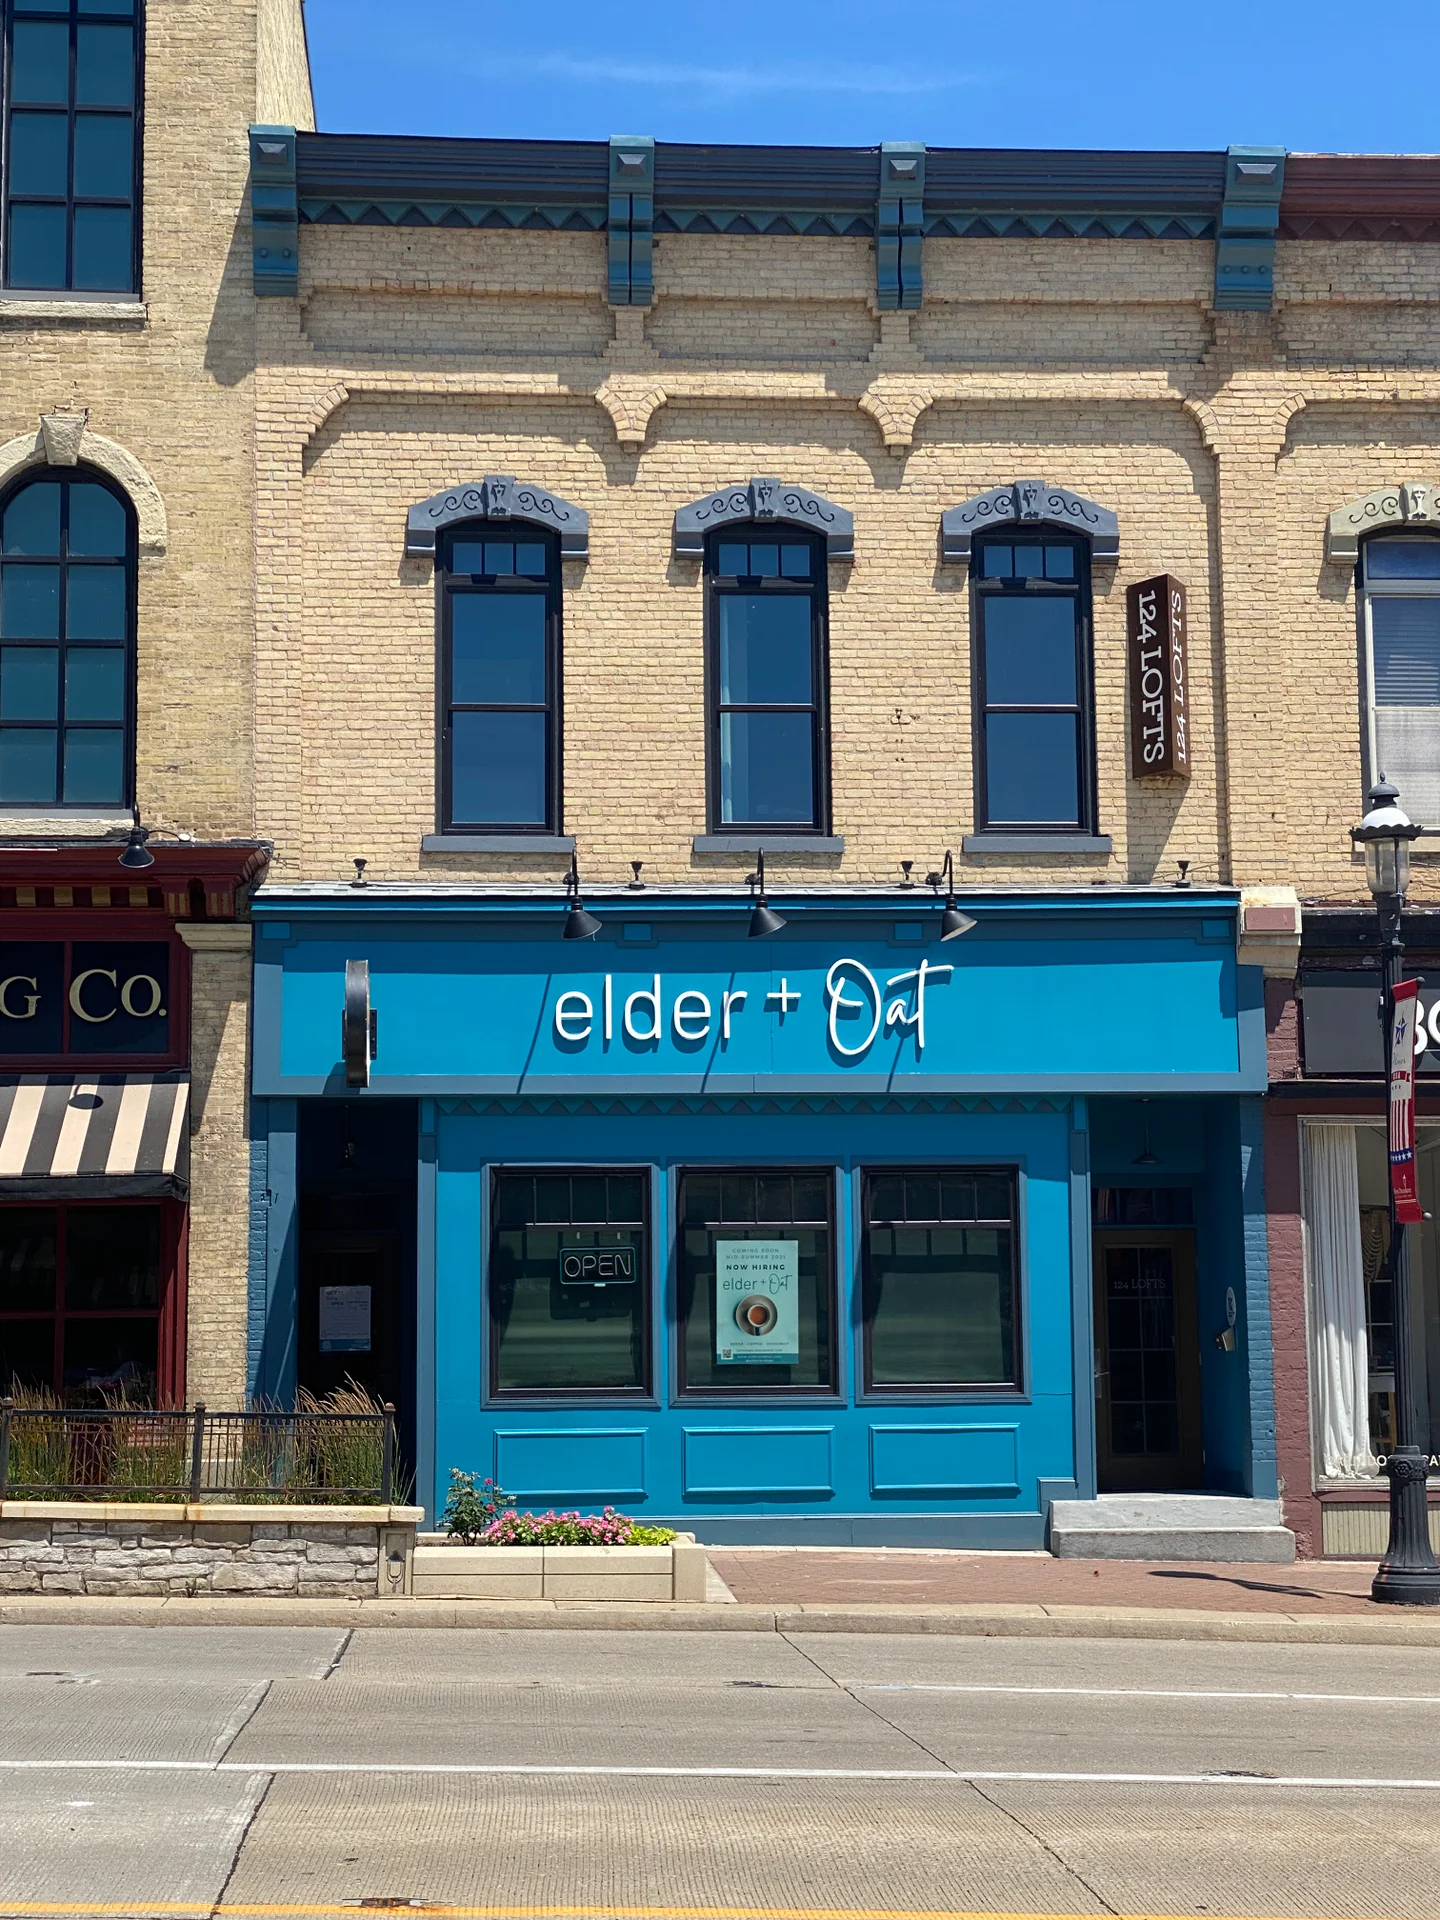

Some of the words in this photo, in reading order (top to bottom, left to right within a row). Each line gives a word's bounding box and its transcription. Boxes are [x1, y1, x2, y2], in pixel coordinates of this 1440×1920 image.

[1136, 589, 1157, 644] 124
[1171, 588, 1184, 707] LOFTS
[1140, 645, 1165, 764] LOFTS
[1176, 713, 1187, 765] 124
[554, 973, 748, 1041] elder
[826, 958, 955, 1056] Oat
[564, 1254, 631, 1277] OPEN
[722, 1277, 758, 1291] elder
[768, 1272, 793, 1295] Oat
[1113, 1281, 1129, 1289] 124
[1131, 1279, 1166, 1289] LOFTS
